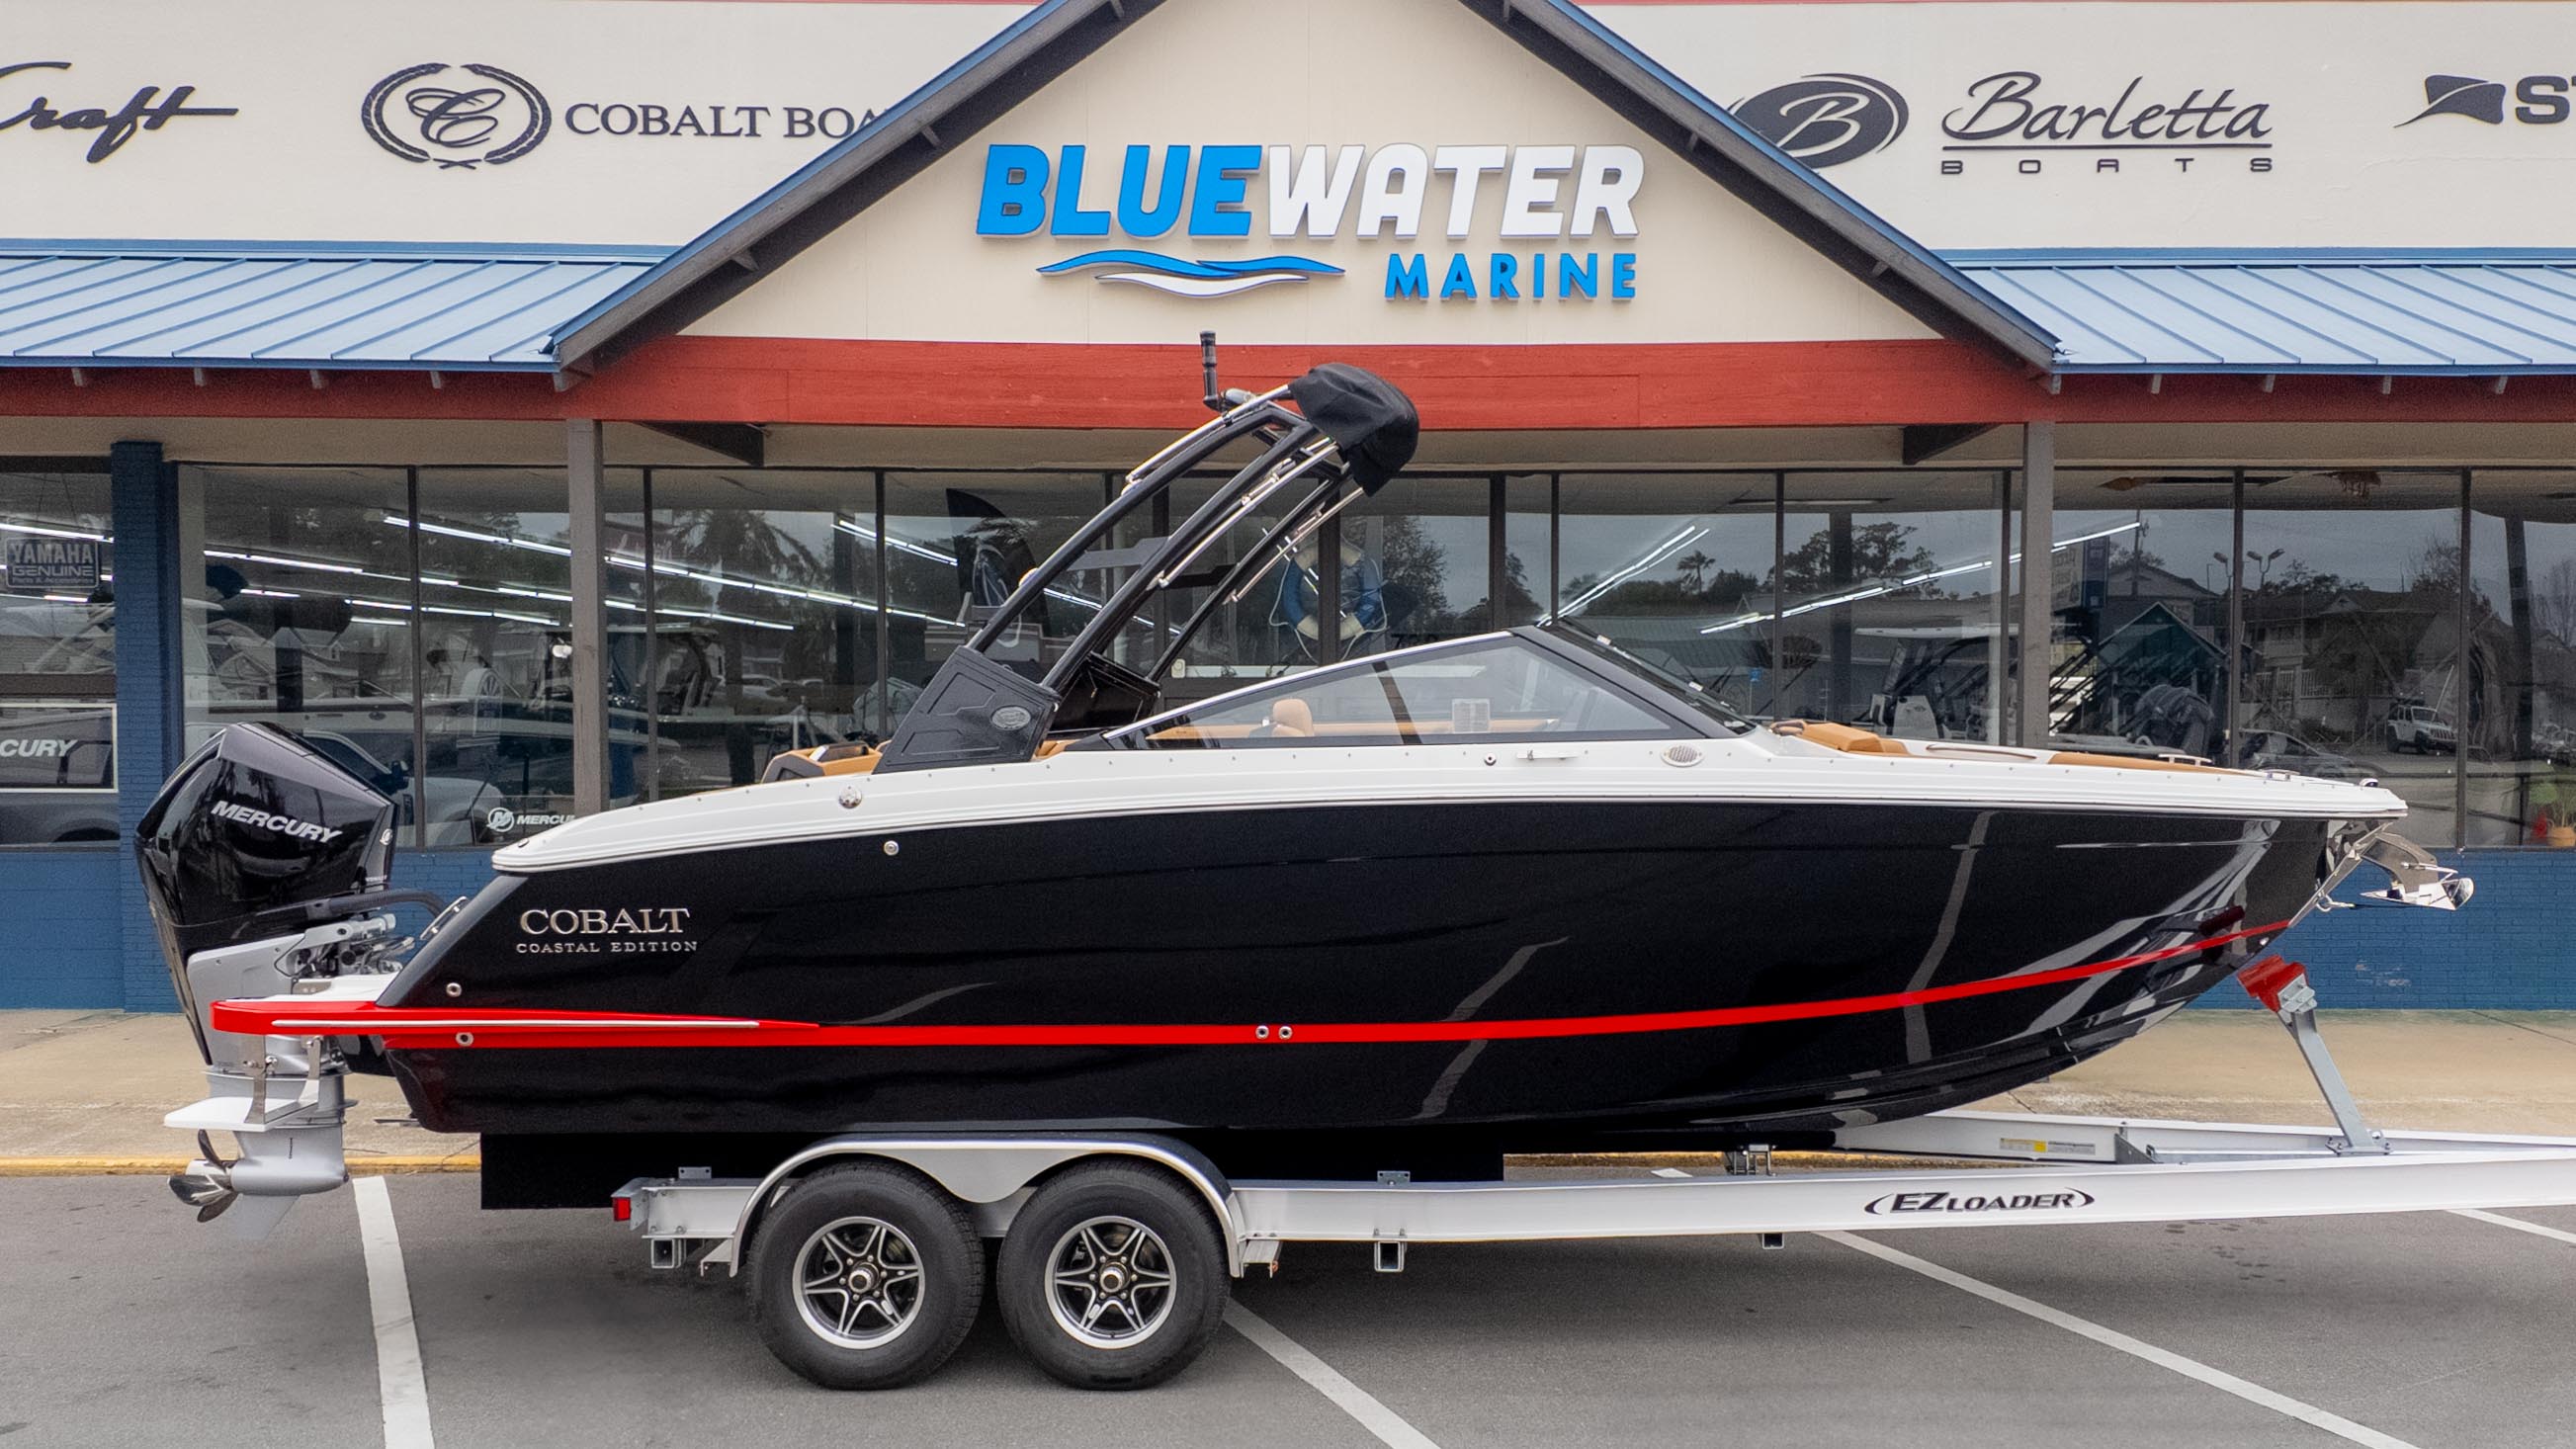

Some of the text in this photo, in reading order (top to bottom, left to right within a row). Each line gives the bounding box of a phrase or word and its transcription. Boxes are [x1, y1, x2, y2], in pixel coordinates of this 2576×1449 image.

[1941, 71, 2273, 140] Barletta
[2515, 74, 2576, 126] S
[564, 103, 889, 138] COBALT BOA
[1941, 157, 2274, 175] BOATS
[977, 144, 1645, 239] BLUEWATER
[1384, 253, 1637, 299] MARINE
[9, 543, 94, 563] YAMAHA
[12, 565, 94, 576] GENUINE
[211, 800, 343, 843] MERCURY
[520, 908, 690, 935] COBALT
[516, 941, 698, 954] COASTAL EDITION
